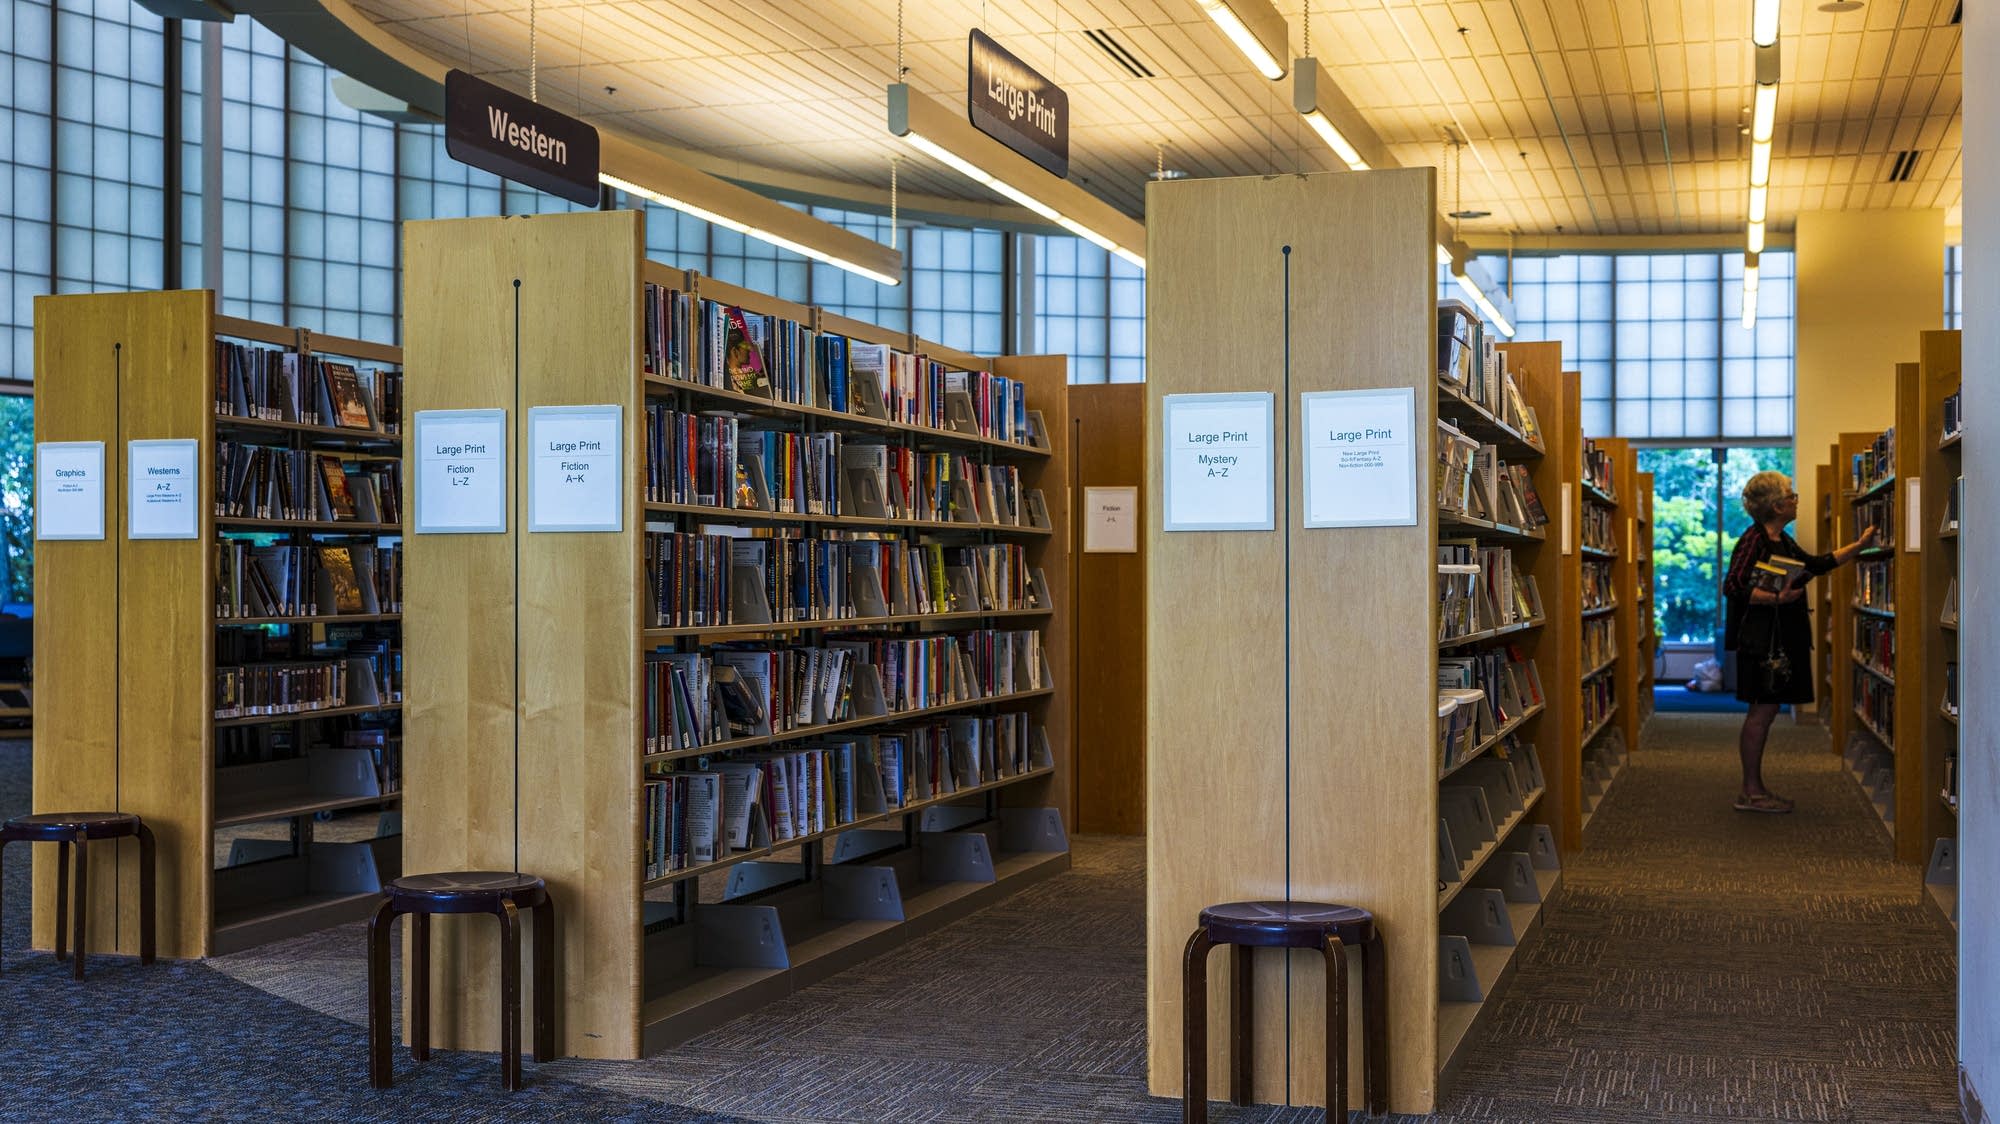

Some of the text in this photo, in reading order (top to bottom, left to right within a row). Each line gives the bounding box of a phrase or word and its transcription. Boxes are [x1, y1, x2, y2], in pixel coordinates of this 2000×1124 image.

[988, 62, 1057, 139] Large Print
[488, 104, 567, 165] Western
[1188, 431, 1248, 444] Large Print
[1330, 428, 1392, 442] Large Print
[436, 444, 486, 456] Large Print
[550, 441, 601, 453] Large Print
[1198, 454, 1238, 467] Mystery
[147, 467, 180, 475] Westerns
[447, 465, 475, 474] Fiction
[561, 462, 589, 471] Fiction
[55, 469, 86, 478] Graphics
[1207, 468, 1229, 477] A-Z
[452, 477, 470, 486] L-Z
[565, 474, 585, 483] A-K
